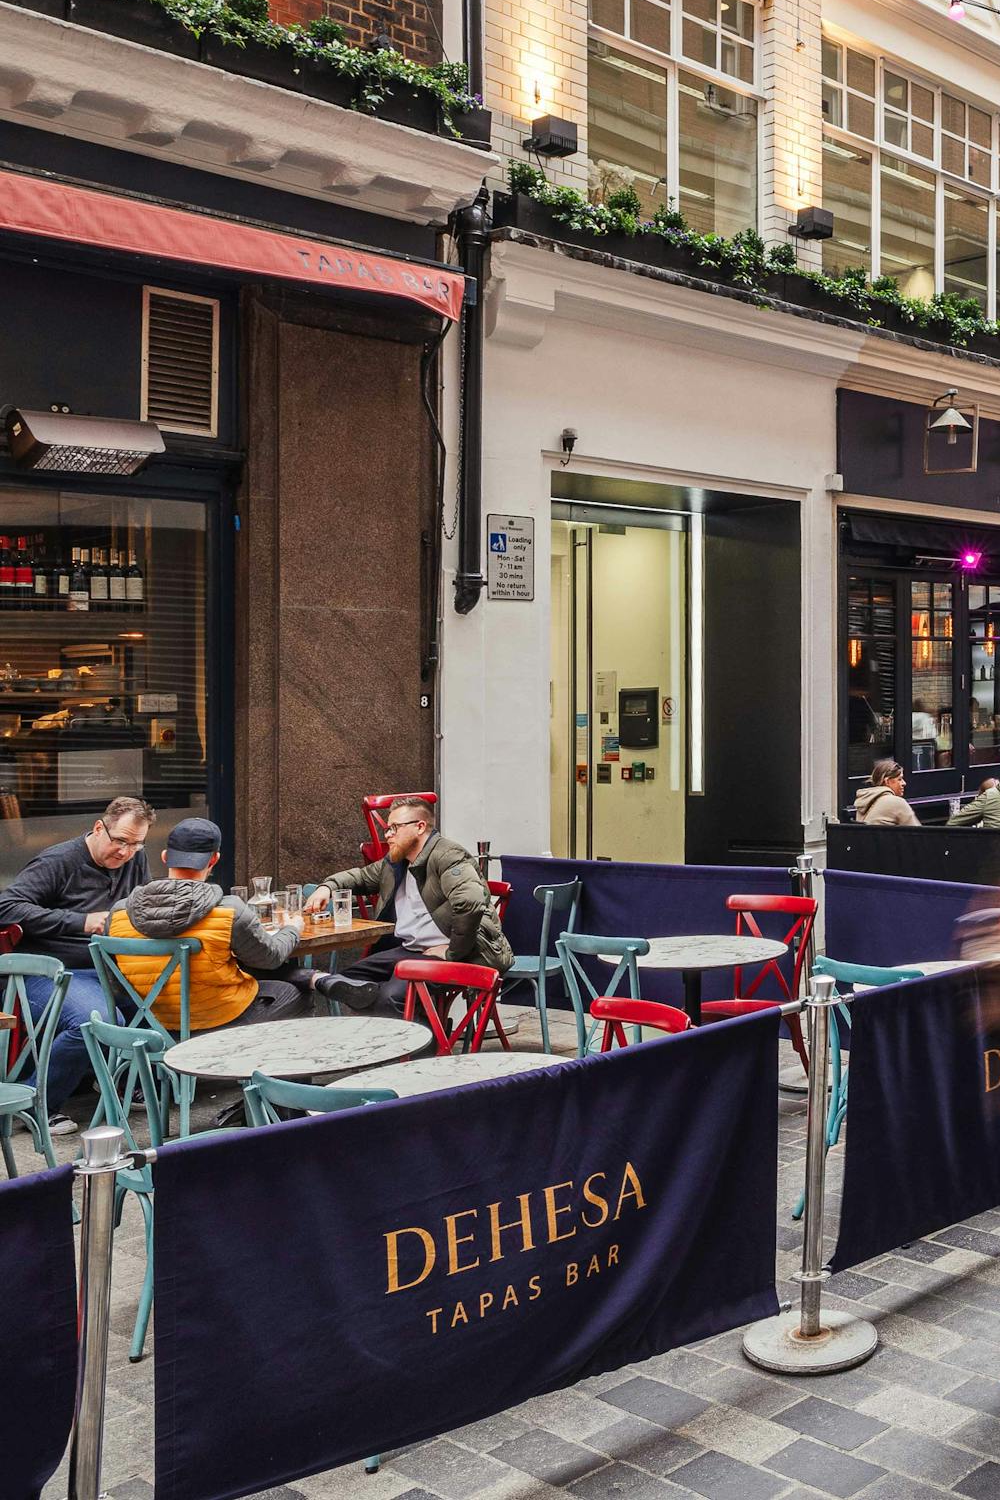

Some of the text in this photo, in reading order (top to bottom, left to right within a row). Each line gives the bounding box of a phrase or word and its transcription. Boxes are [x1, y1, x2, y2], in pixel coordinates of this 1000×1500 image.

[508, 536, 531, 544] Loading
[421, 696, 428, 707] 8
[382, 1162, 647, 1294] DEHESA
[426, 1244, 619, 1334] TAPAS BAR
